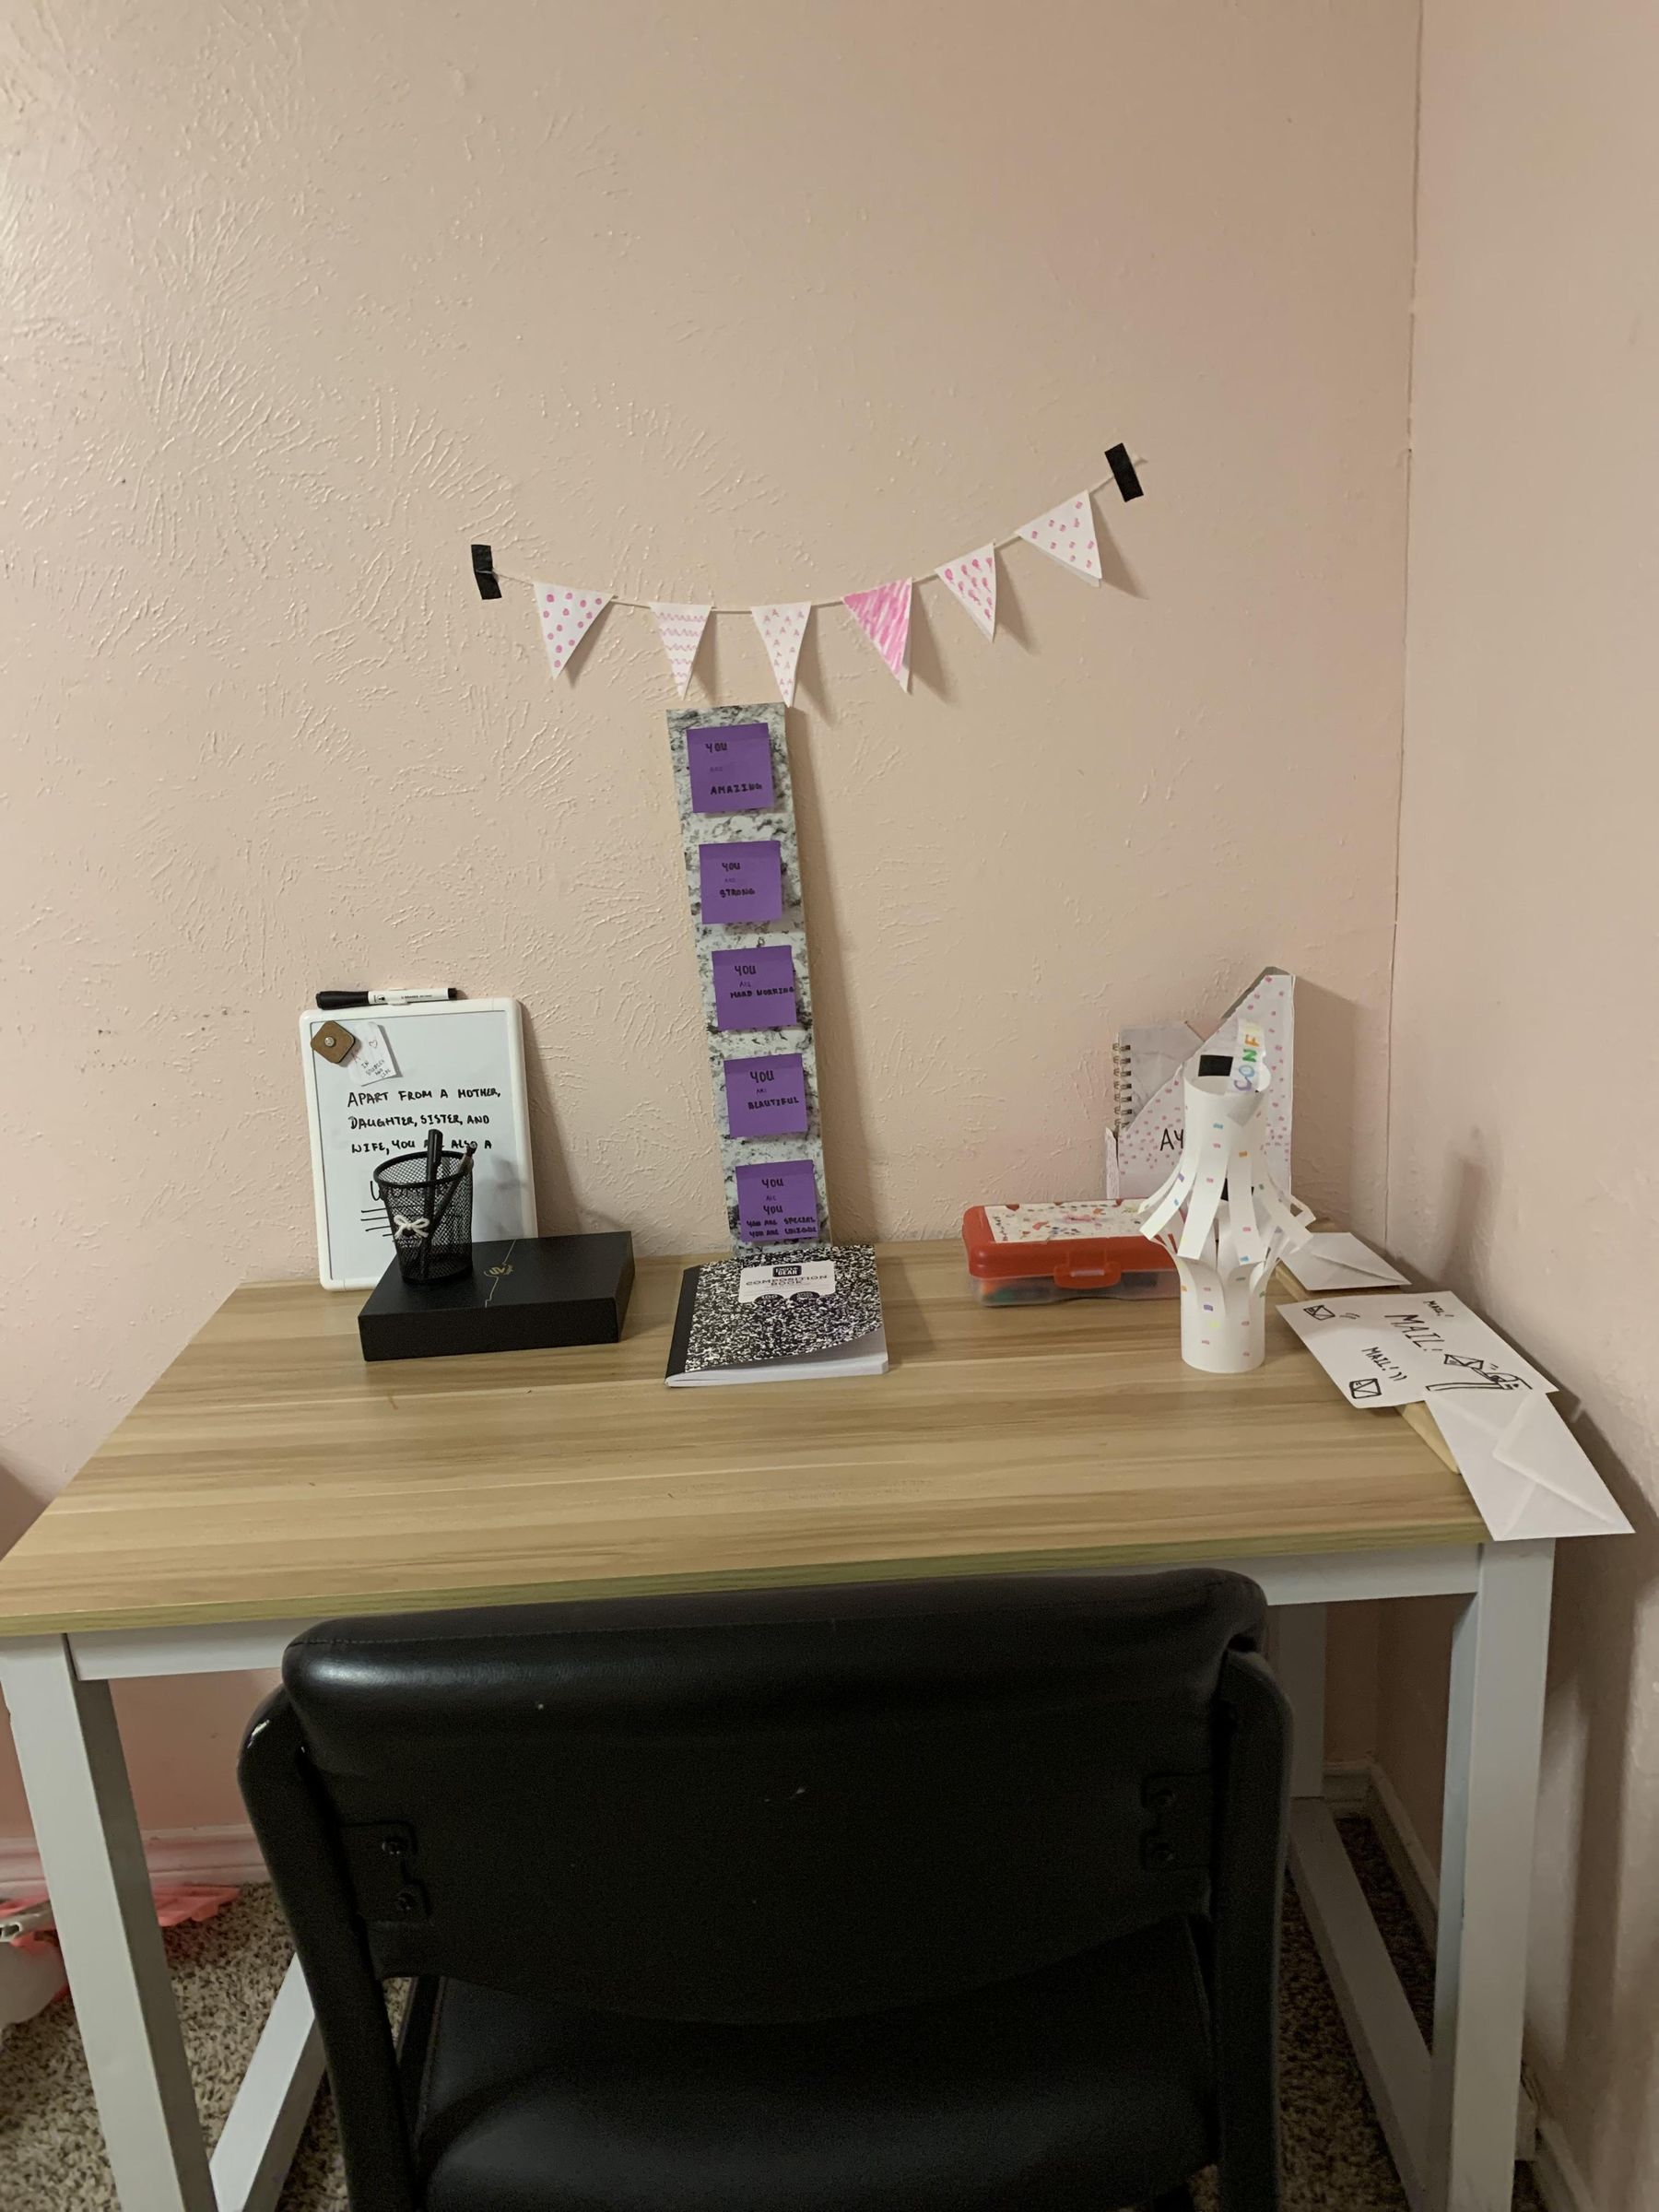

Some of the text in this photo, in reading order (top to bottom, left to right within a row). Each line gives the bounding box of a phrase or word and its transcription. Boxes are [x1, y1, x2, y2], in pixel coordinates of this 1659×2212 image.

[705, 742, 727, 753] YOU
[722, 863, 741, 872] YOU
[734, 965, 756, 976] YOU
[749, 1070, 774, 1083] YOU
[347, 1088, 500, 1107] APART FROM A MOTHER,
[747, 1096, 799, 1110] BEAUTIFUL
[347, 1113, 489, 1129] DAUGHTER, SISTER, AND
[351, 1142, 390, 1156] WIFE,
[392, 1139, 416, 1149] YOU
[484, 1139, 492, 1149] A
[761, 1178, 783, 1189] YOU
[763, 1205, 783, 1215] YOU
